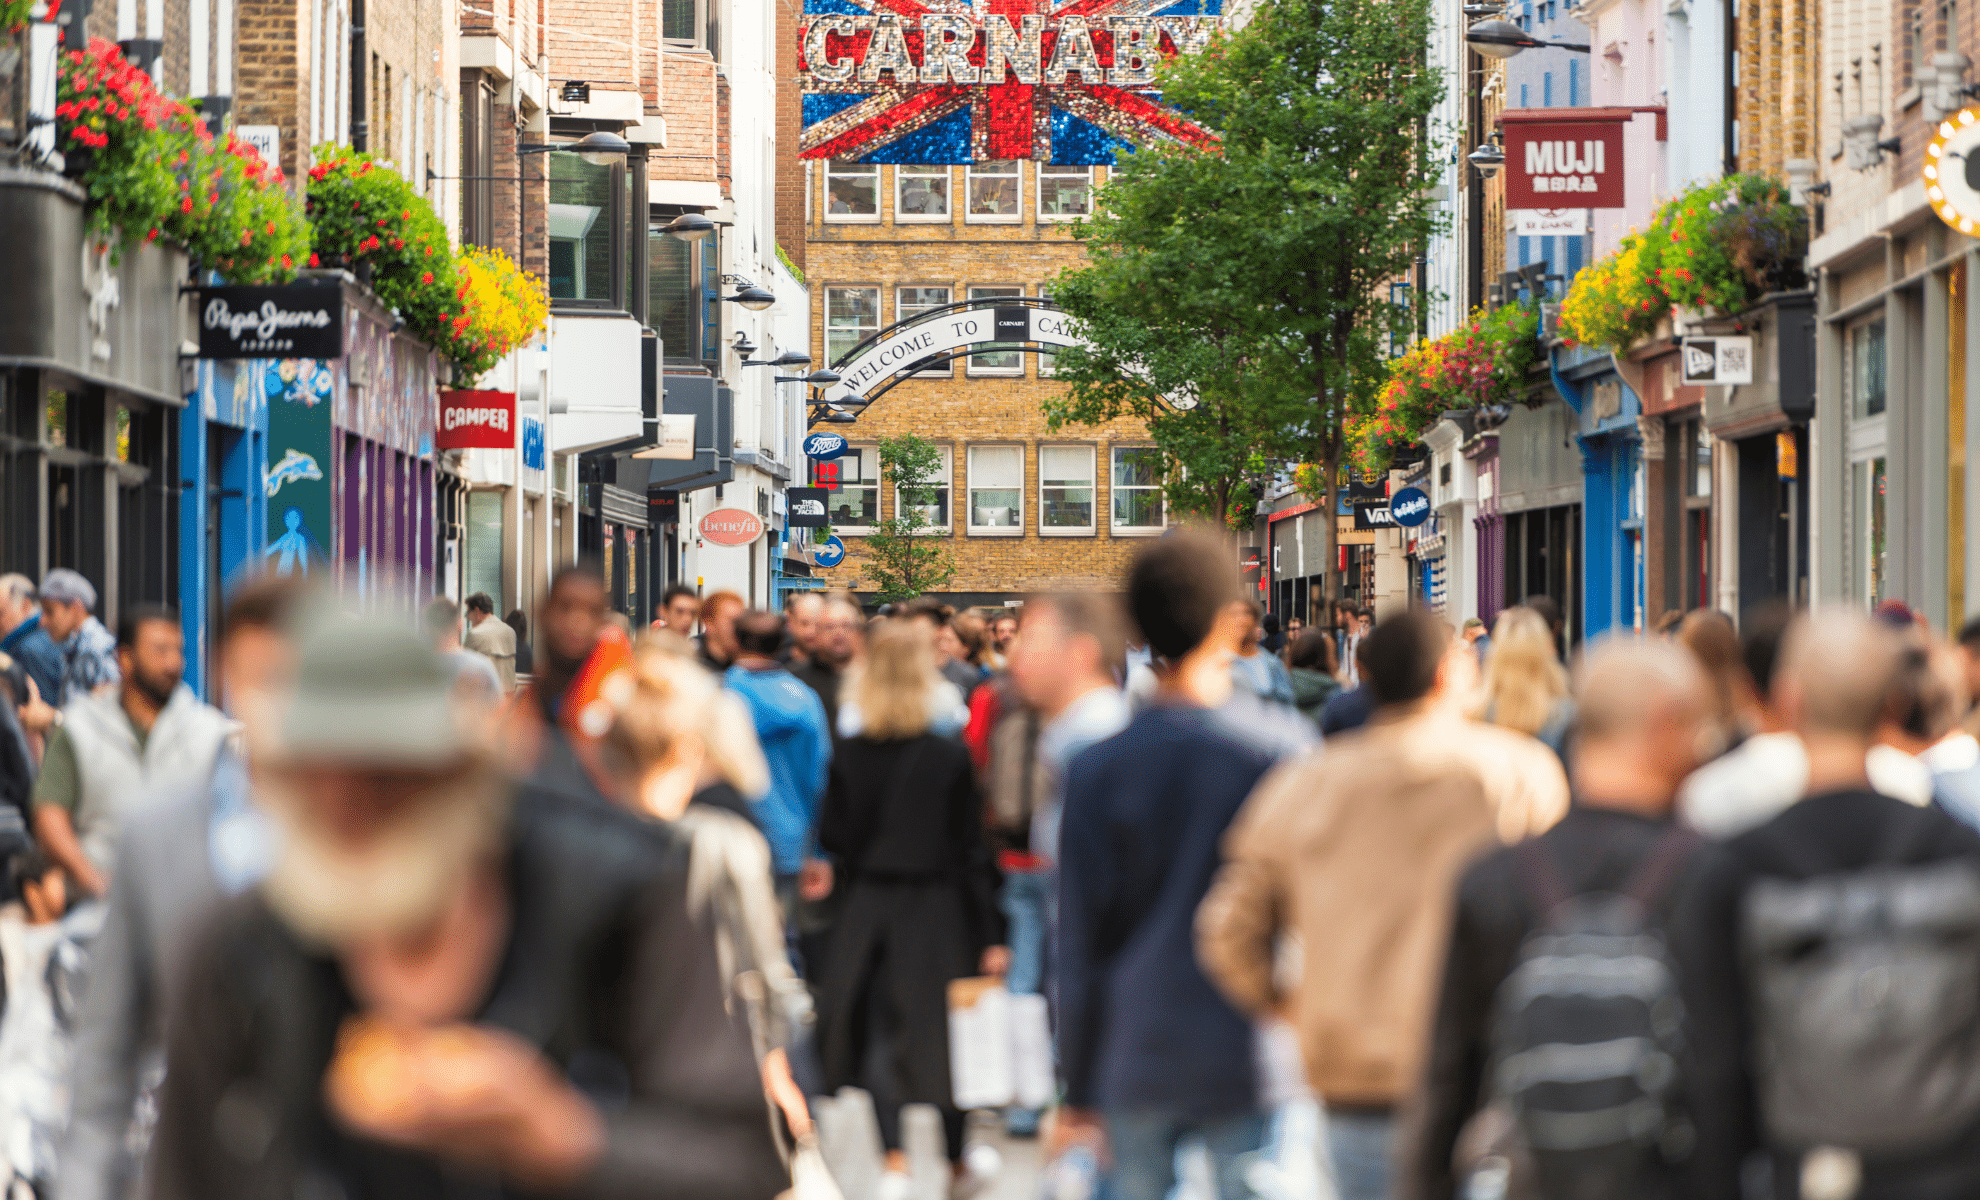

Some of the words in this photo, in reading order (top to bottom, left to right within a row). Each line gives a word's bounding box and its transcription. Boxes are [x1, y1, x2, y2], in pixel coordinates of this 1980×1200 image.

[1525, 140, 1604, 174] MUJI
[204, 298, 259, 340] Pepe
[257, 299, 331, 340] Jeans
[843, 331, 935, 393] WELCOME
[951, 320, 978, 338] TO
[444, 407, 509, 433] CAMPER
[807, 436, 842, 455] Boots
[704, 518, 757, 536] benefit
[1365, 508, 1394, 524] VAN
